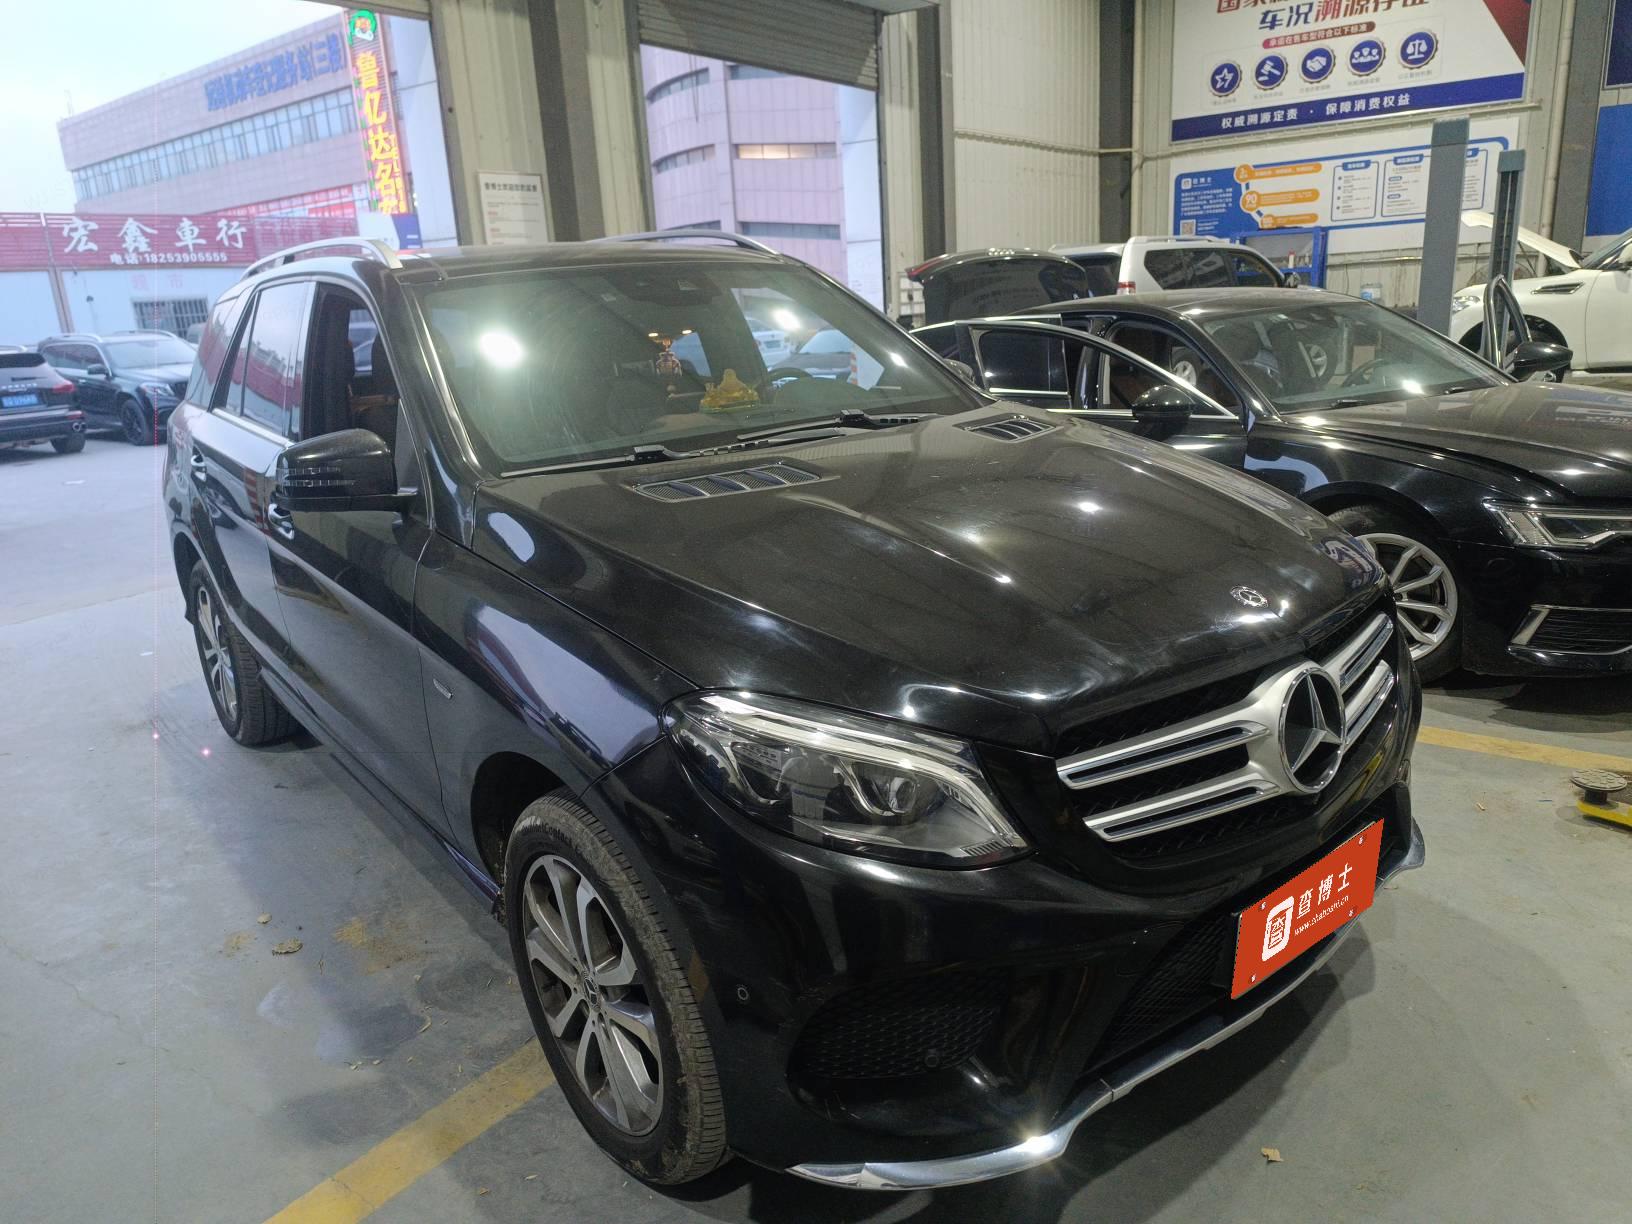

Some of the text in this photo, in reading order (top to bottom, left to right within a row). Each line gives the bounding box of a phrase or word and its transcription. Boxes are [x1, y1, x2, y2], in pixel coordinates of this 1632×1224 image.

[1221, 93, 1411, 129] 权威溯源定责 保障消费权益
[62, 217, 248, 253] 宏鑫車行
